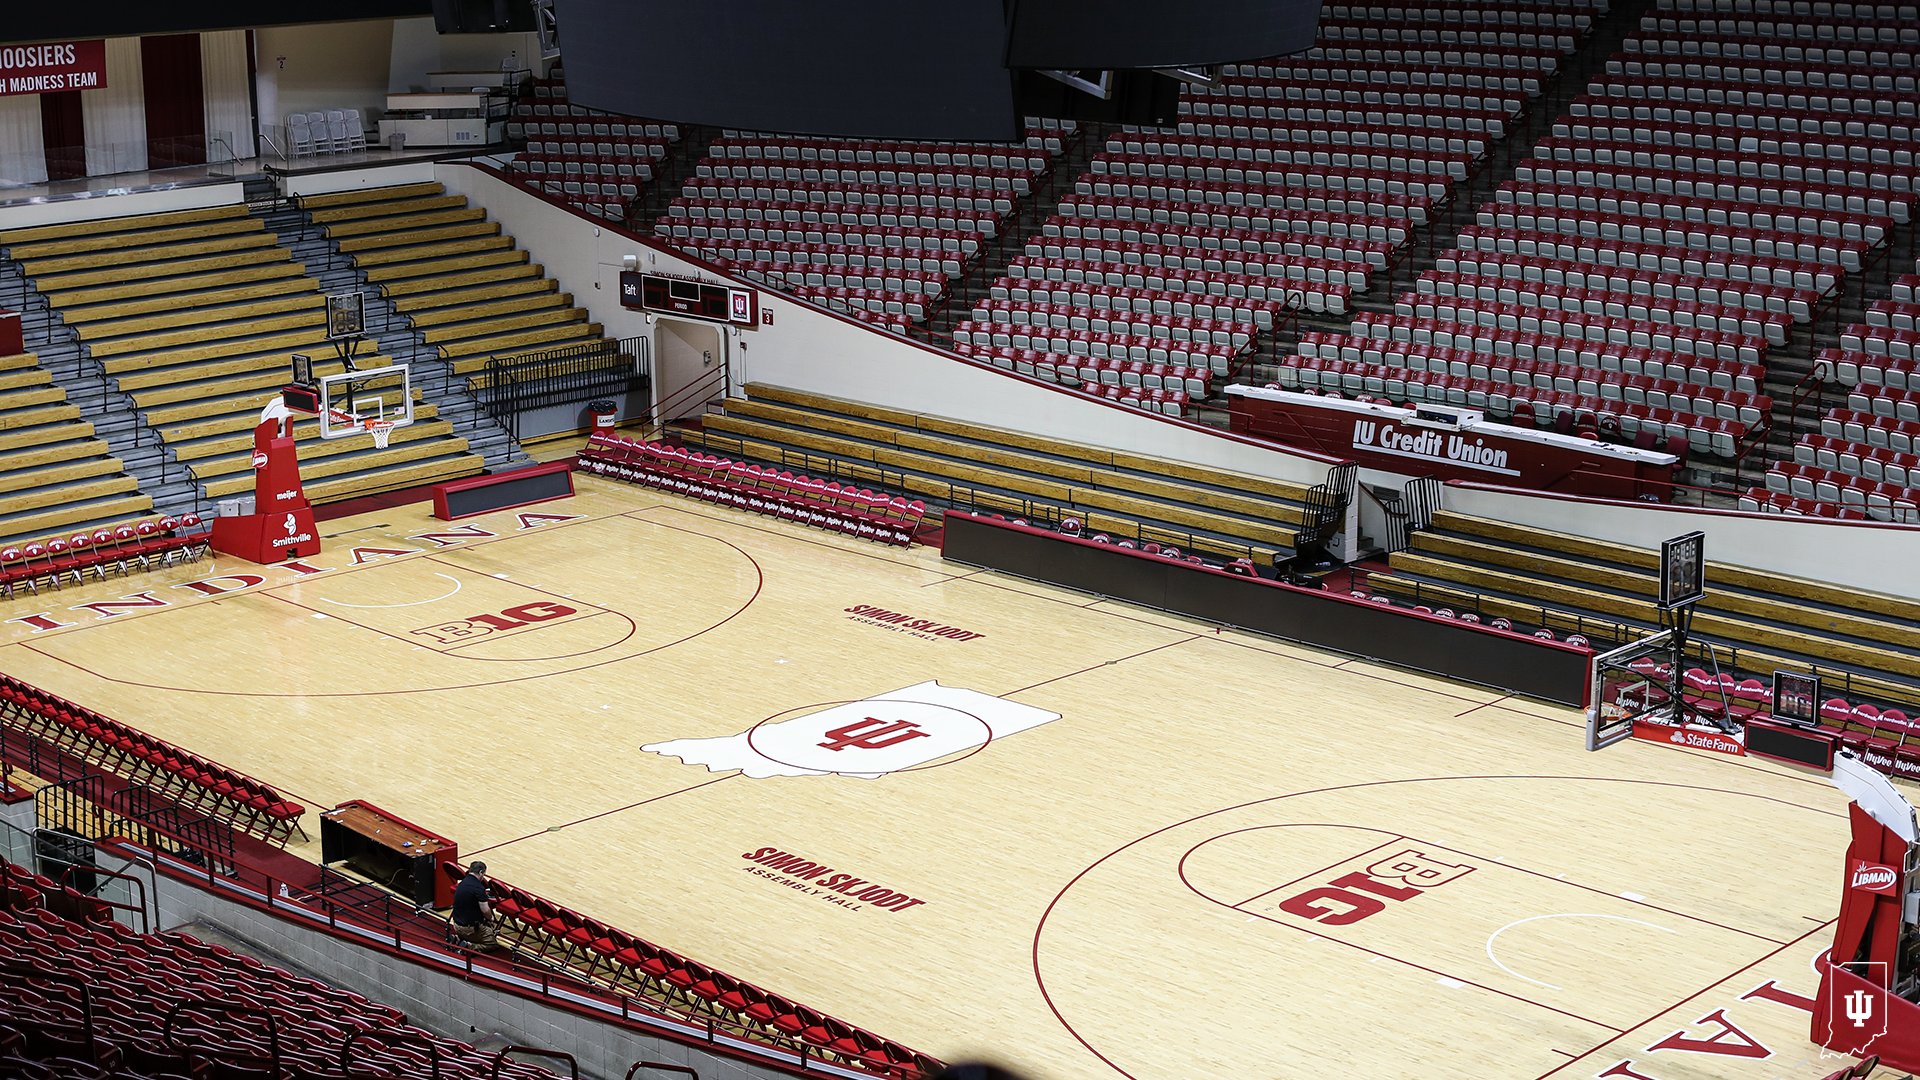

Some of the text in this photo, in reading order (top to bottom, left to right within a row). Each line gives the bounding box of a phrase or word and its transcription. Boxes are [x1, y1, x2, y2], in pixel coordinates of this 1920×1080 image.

[0, 44, 76, 69] OOSIERS
[10, 75, 65, 92] MADNESS
[67, 72, 97, 88] TEAM
[624, 284, 637, 296] Taft
[1353, 420, 1508, 468] IU Credit Union
[277, 490, 297, 500] meijer
[273, 532, 312, 548] Smithville
[843, 604, 986, 642] SIMON SKJODT
[845, 616, 939, 642] ASSEMBLY HALL
[741, 847, 926, 912] SIMON SKJODT
[743, 866, 863, 912] ASSEMBLY HALL
[1851, 871, 1893, 888] LIBMAN
